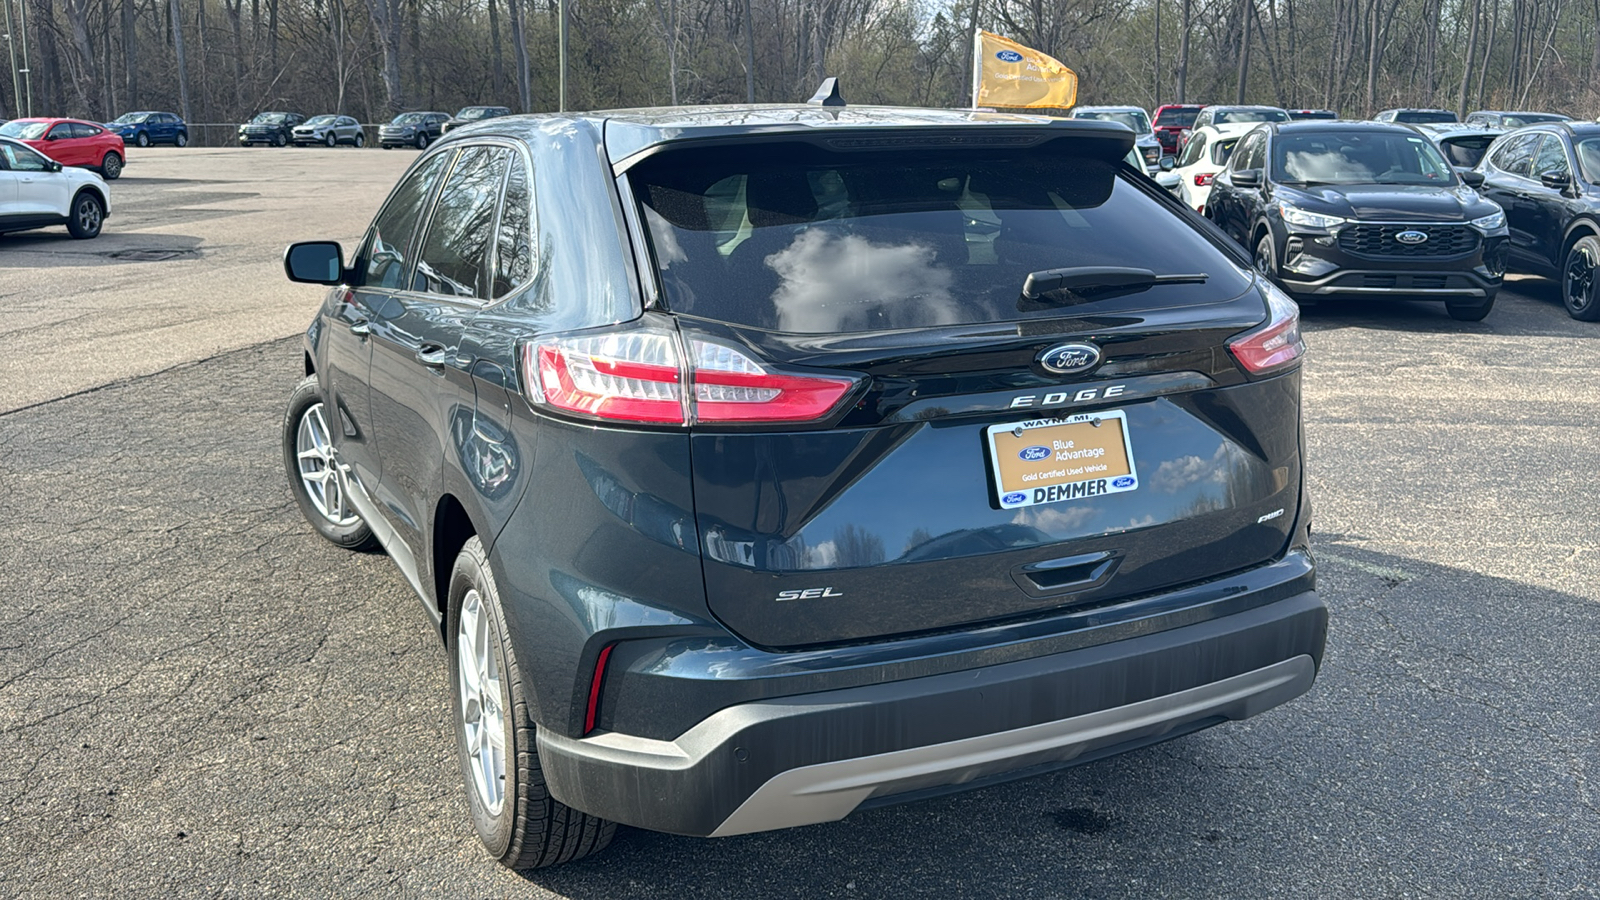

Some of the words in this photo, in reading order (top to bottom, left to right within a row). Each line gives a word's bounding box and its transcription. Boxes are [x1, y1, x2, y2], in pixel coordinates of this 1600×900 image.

[1009, 384, 1126, 409] EDGE
[1074, 414, 1092, 422] MI.
[1053, 440, 1074, 451] Blue
[1055, 446, 1105, 462] Advantage
[1022, 473, 1038, 482] Gold
[1038, 468, 1066, 479] Certified
[1066, 466, 1084, 476] Used
[1084, 463, 1108, 473] Vehicle
[1033, 479, 1108, 504] DEMMER
[775, 586, 843, 602] SEL
